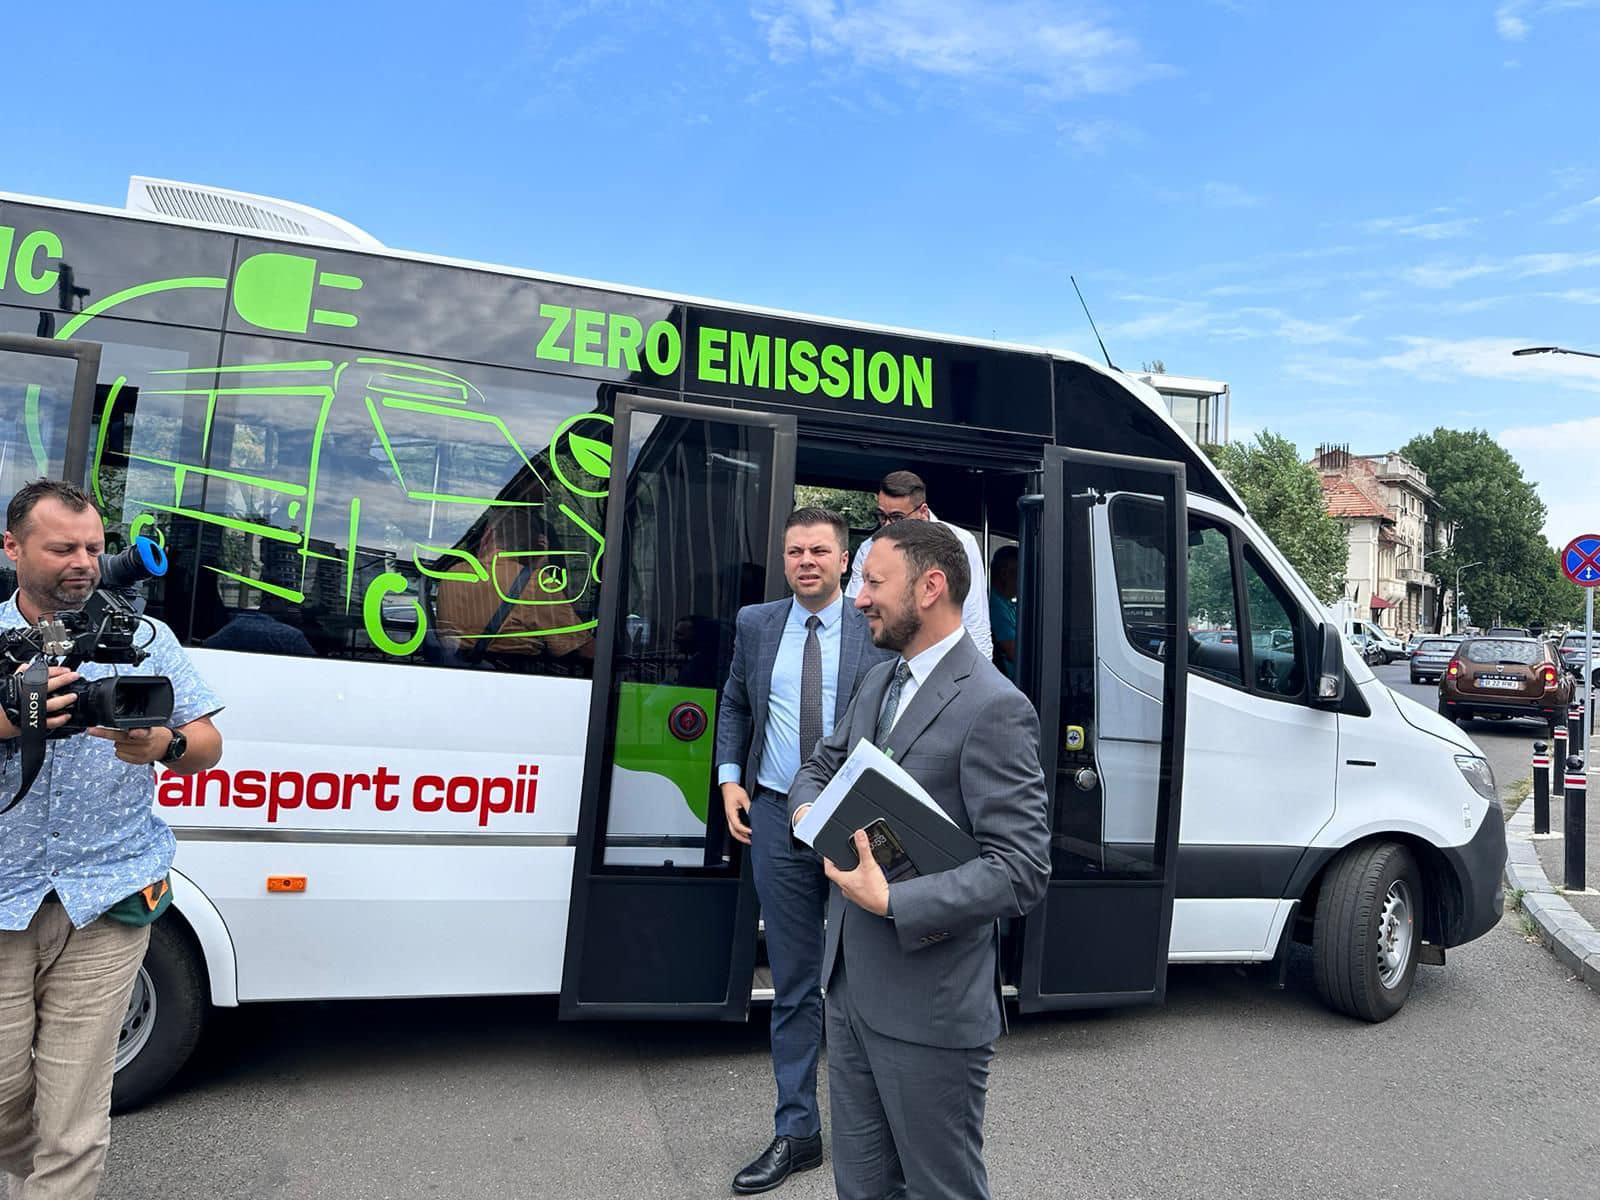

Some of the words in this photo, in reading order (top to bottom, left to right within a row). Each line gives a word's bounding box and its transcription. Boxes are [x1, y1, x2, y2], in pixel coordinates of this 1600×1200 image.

[536, 304, 682, 376] ZERO
[697, 326, 934, 409] EMISSION
[29, 692, 39, 729] SONY
[152, 767, 400, 824] ansport
[411, 766, 540, 828] copii
